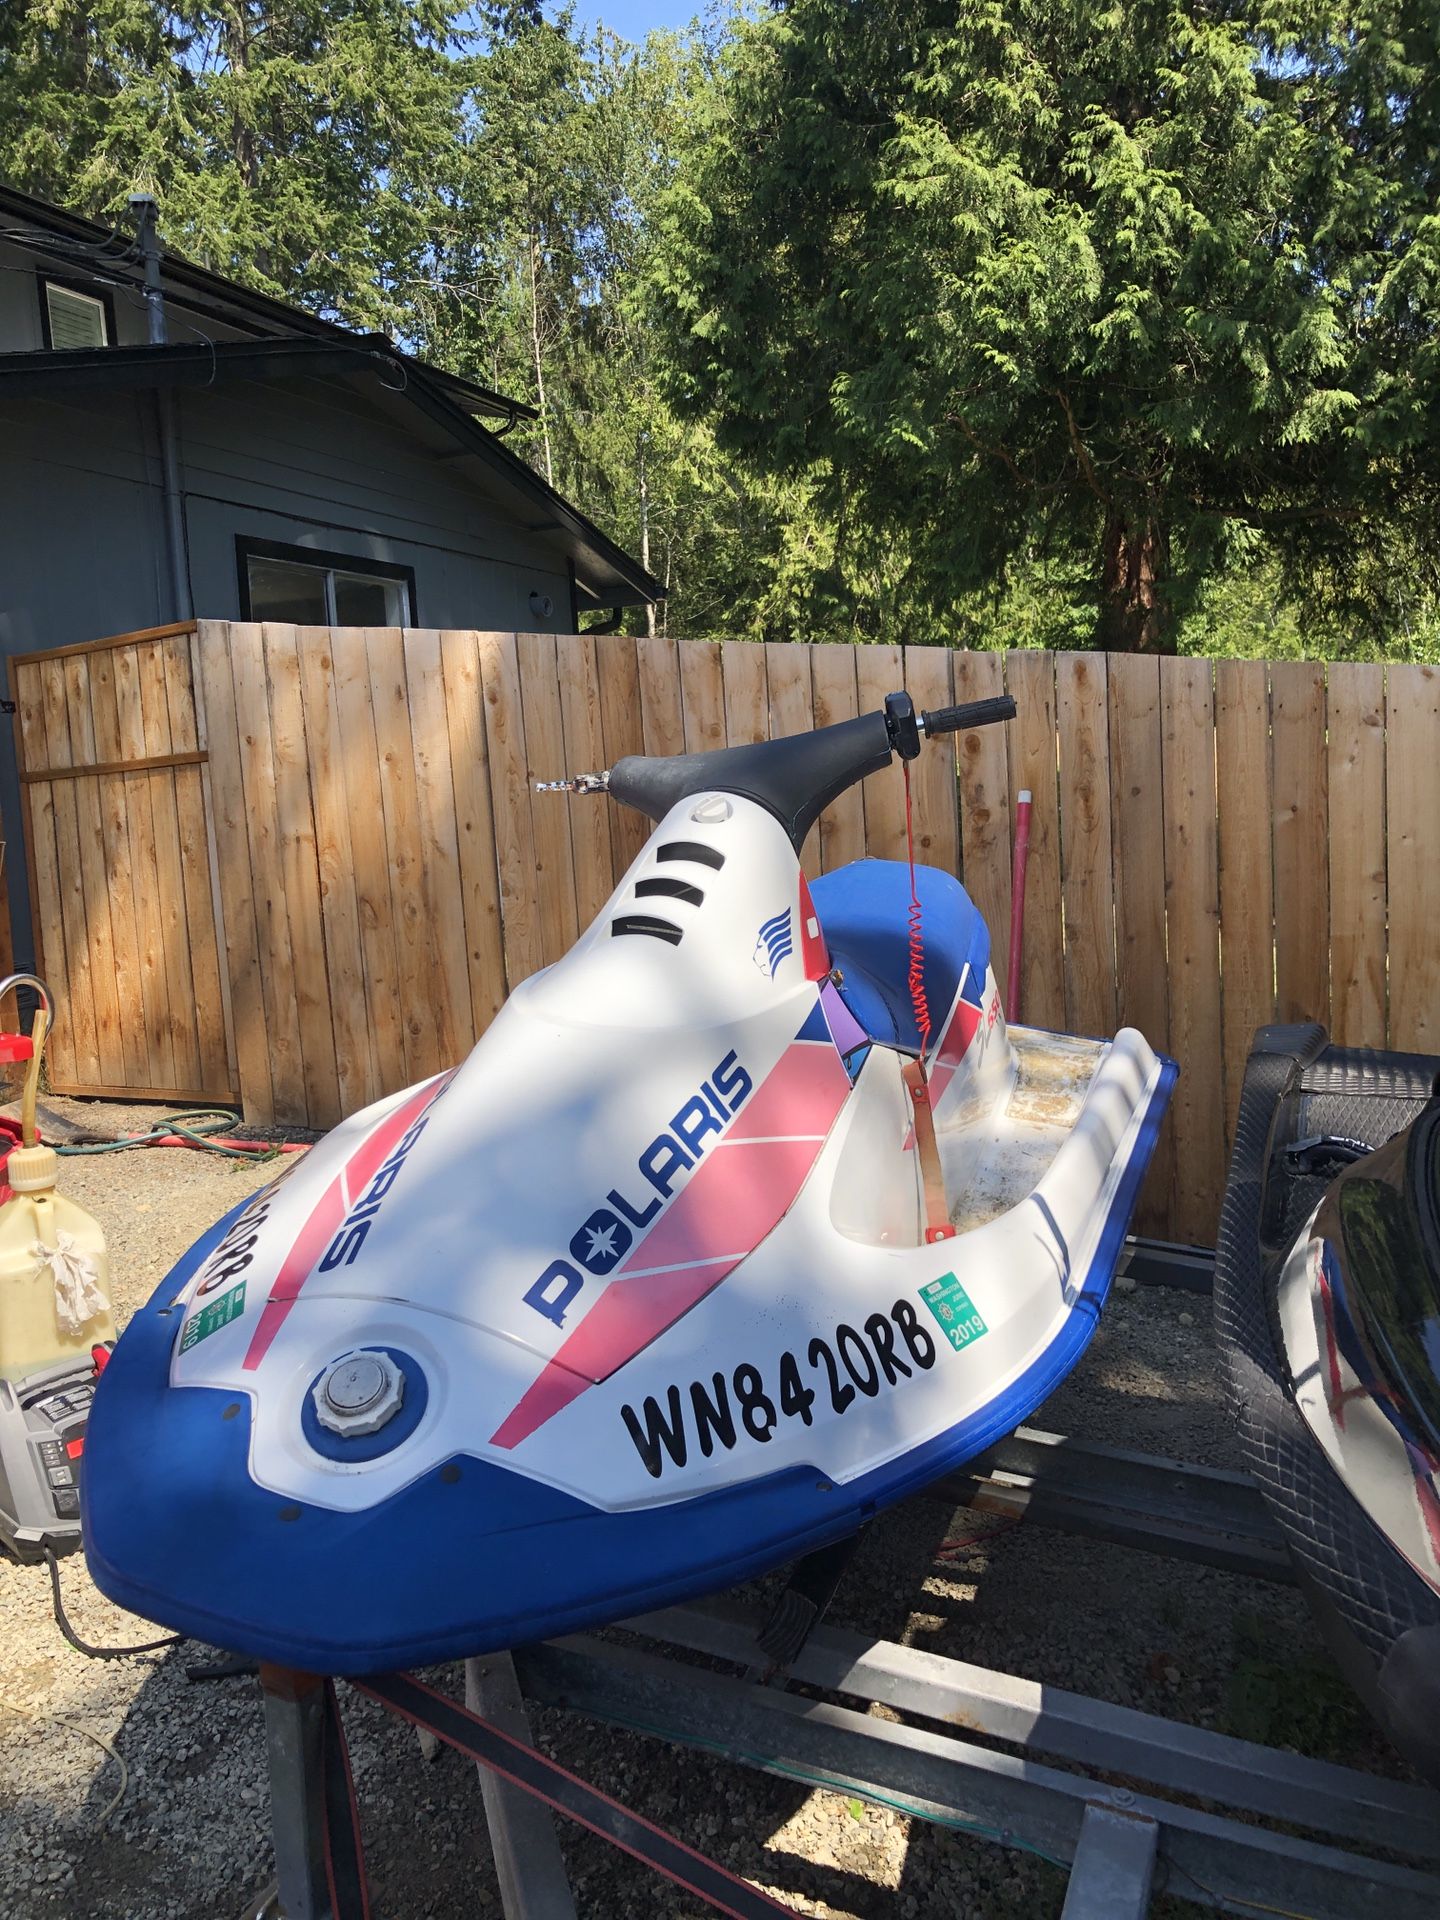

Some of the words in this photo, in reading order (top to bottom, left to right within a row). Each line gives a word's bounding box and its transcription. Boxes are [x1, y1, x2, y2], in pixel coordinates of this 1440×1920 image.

[522, 1049, 754, 1330] POLARIS
[182, 1312, 203, 1351] 2019
[950, 1315, 984, 1346] 2019
[620, 1299, 936, 1479] WN8420RB
